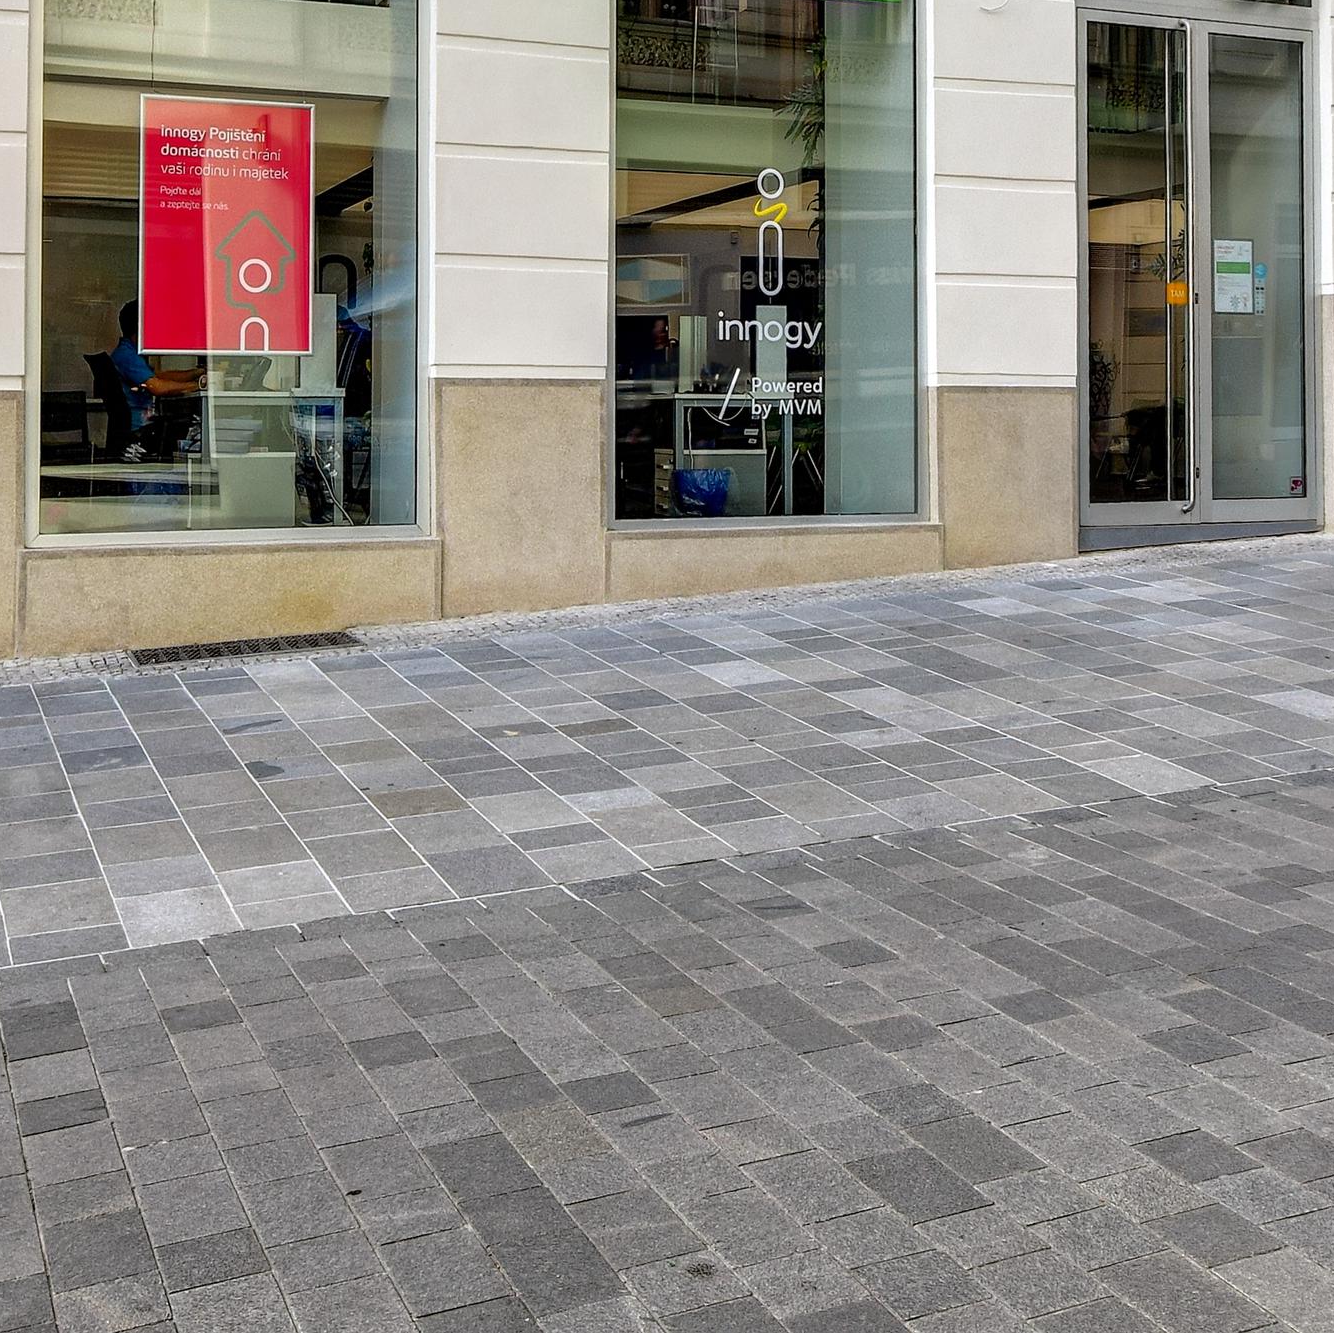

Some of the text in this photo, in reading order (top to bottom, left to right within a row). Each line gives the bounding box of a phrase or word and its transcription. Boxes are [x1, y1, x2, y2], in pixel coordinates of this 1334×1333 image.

[161, 125, 266, 143] innogy Pojištění
[161, 143, 282, 161] domácnosti chrání
[160, 162, 289, 181] vaši rodinu i majetek
[167, 201, 200, 211] zeptejte
[718, 311, 822, 349] innogy
[751, 377, 823, 394] Powered
[751, 399, 822, 419] by MVM
